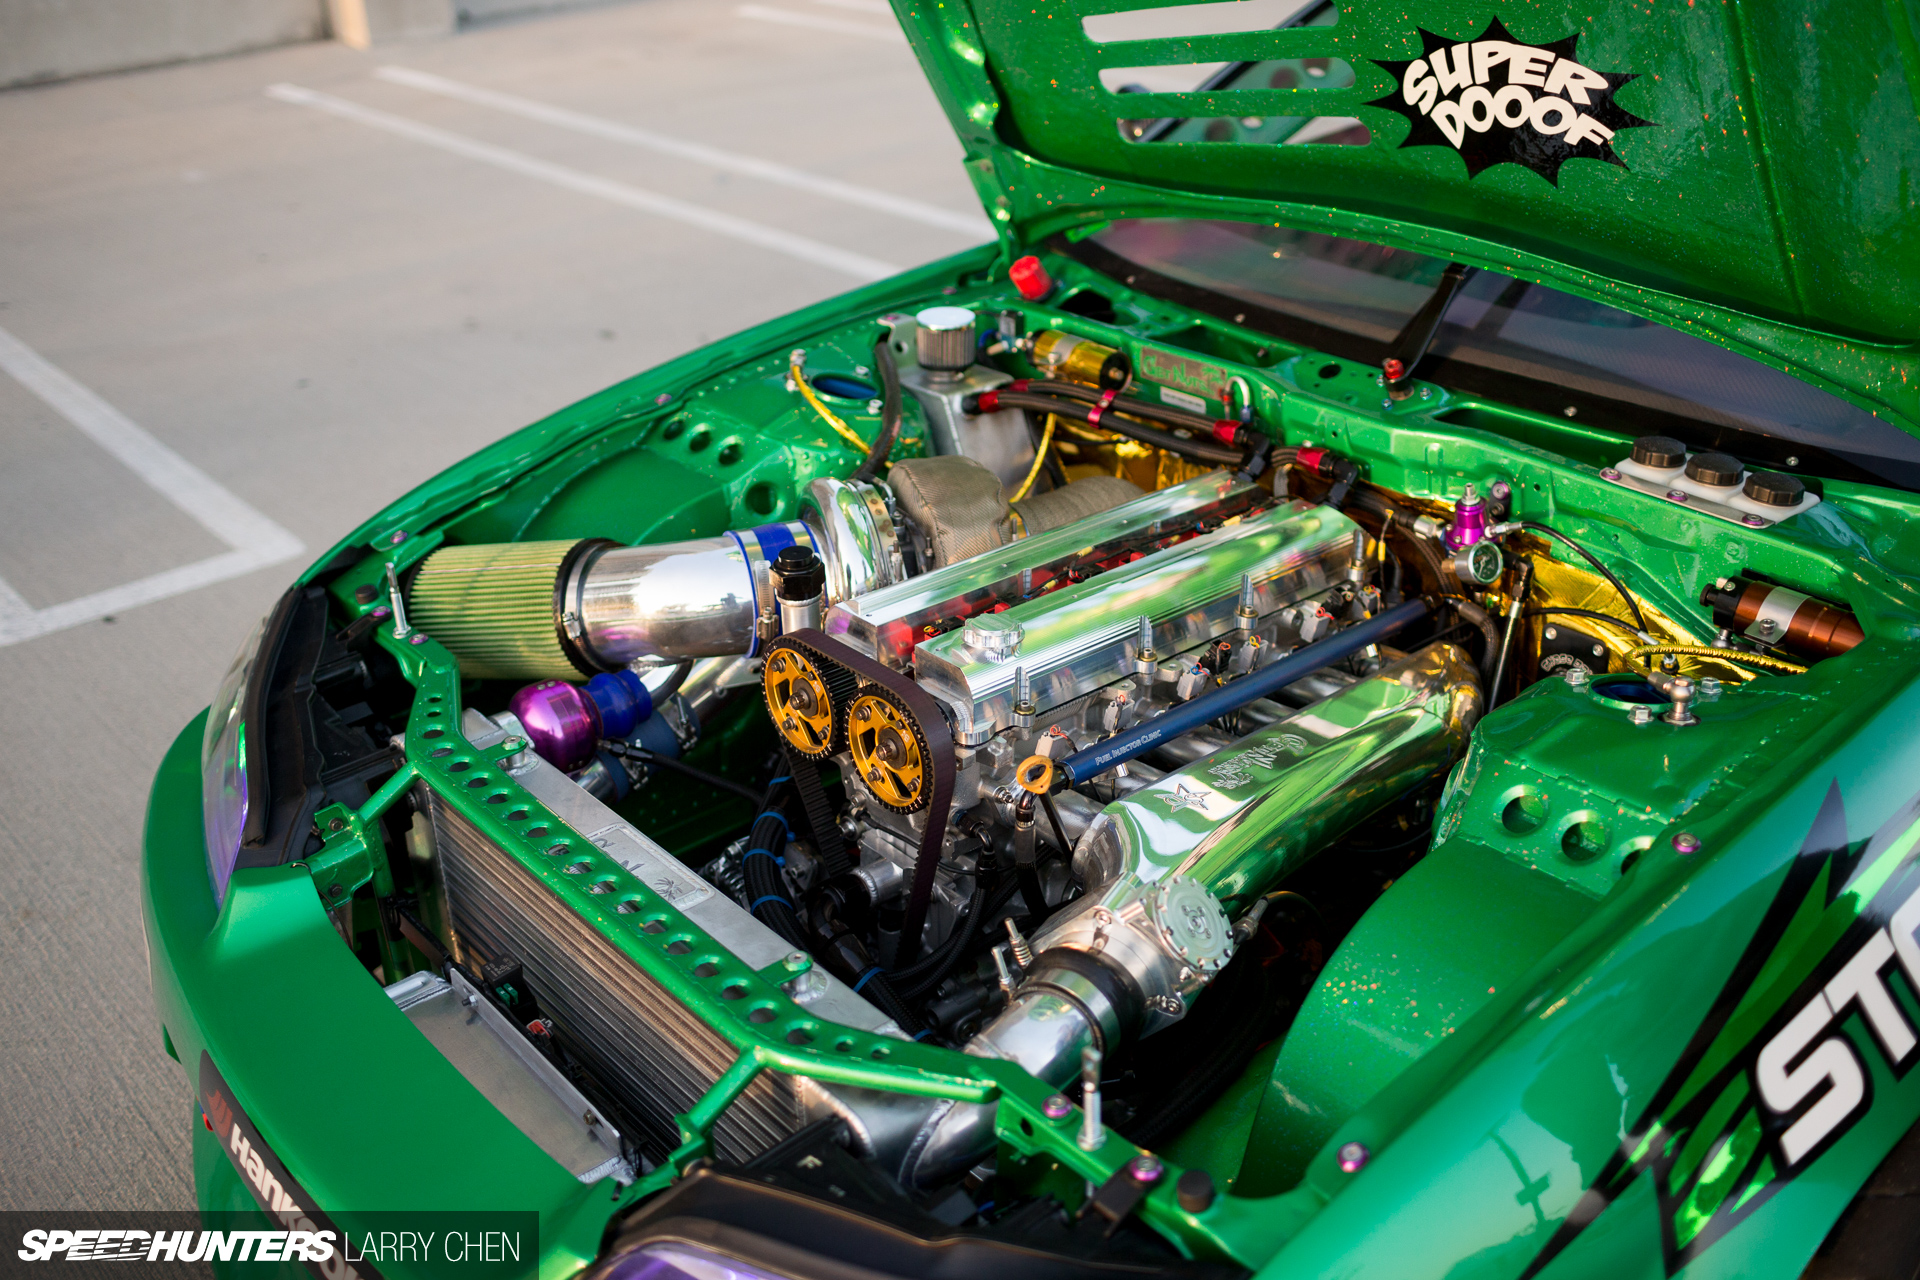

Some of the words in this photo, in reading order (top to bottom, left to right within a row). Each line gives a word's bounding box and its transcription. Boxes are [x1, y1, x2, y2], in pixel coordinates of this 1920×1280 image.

[1402, 40, 1609, 116] SUPER
[1430, 85, 1615, 150] DOOOF
[1756, 884, 1920, 1166] ST
